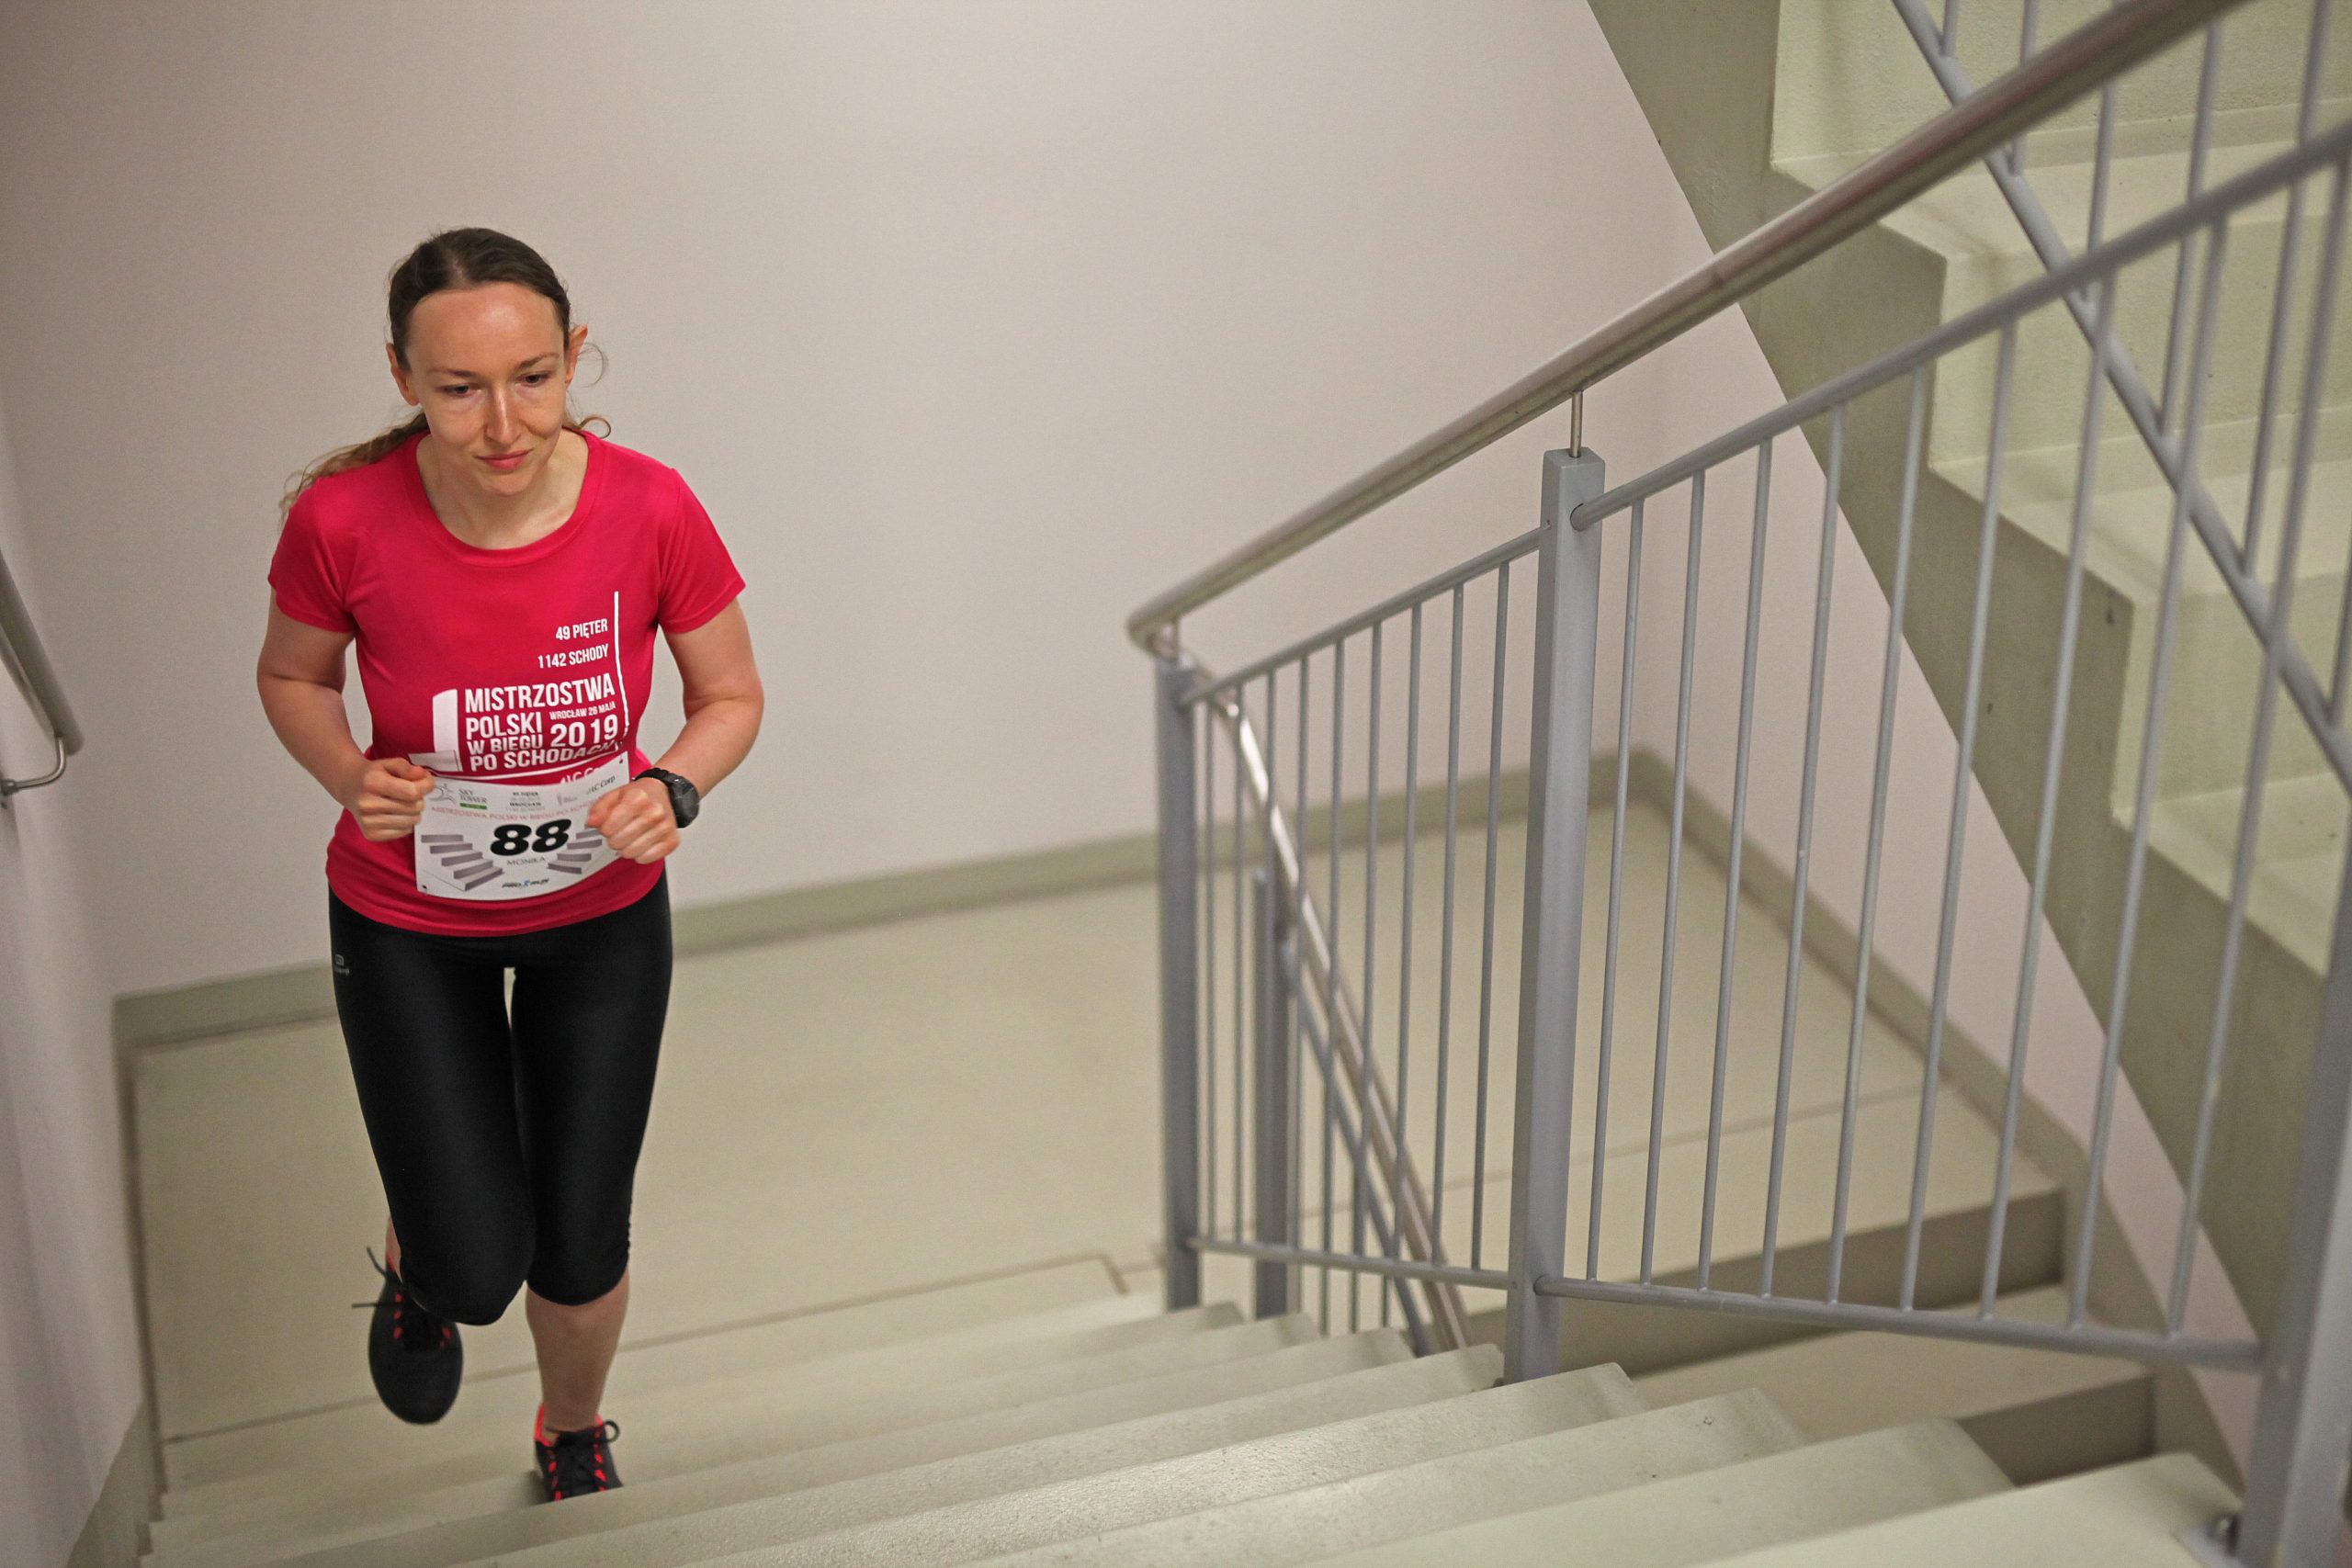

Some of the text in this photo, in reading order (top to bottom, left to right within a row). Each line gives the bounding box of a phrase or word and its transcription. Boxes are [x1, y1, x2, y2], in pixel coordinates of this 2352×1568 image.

[556, 618, 608, 640] 49 PIĘTER
[537, 643, 609, 669] 1142 SCHODY
[465, 673, 616, 714] MISTRZOSTWA
[548, 701, 616, 720] WROCŁAW 26 MAJA
[466, 711, 543, 740] POLSKI
[550, 714, 618, 748] 2019
[467, 734, 543, 755] W BIEGU
[469, 753, 497, 772] PO
[490, 818, 572, 856] 88
[506, 856, 546, 867] MONIKA
